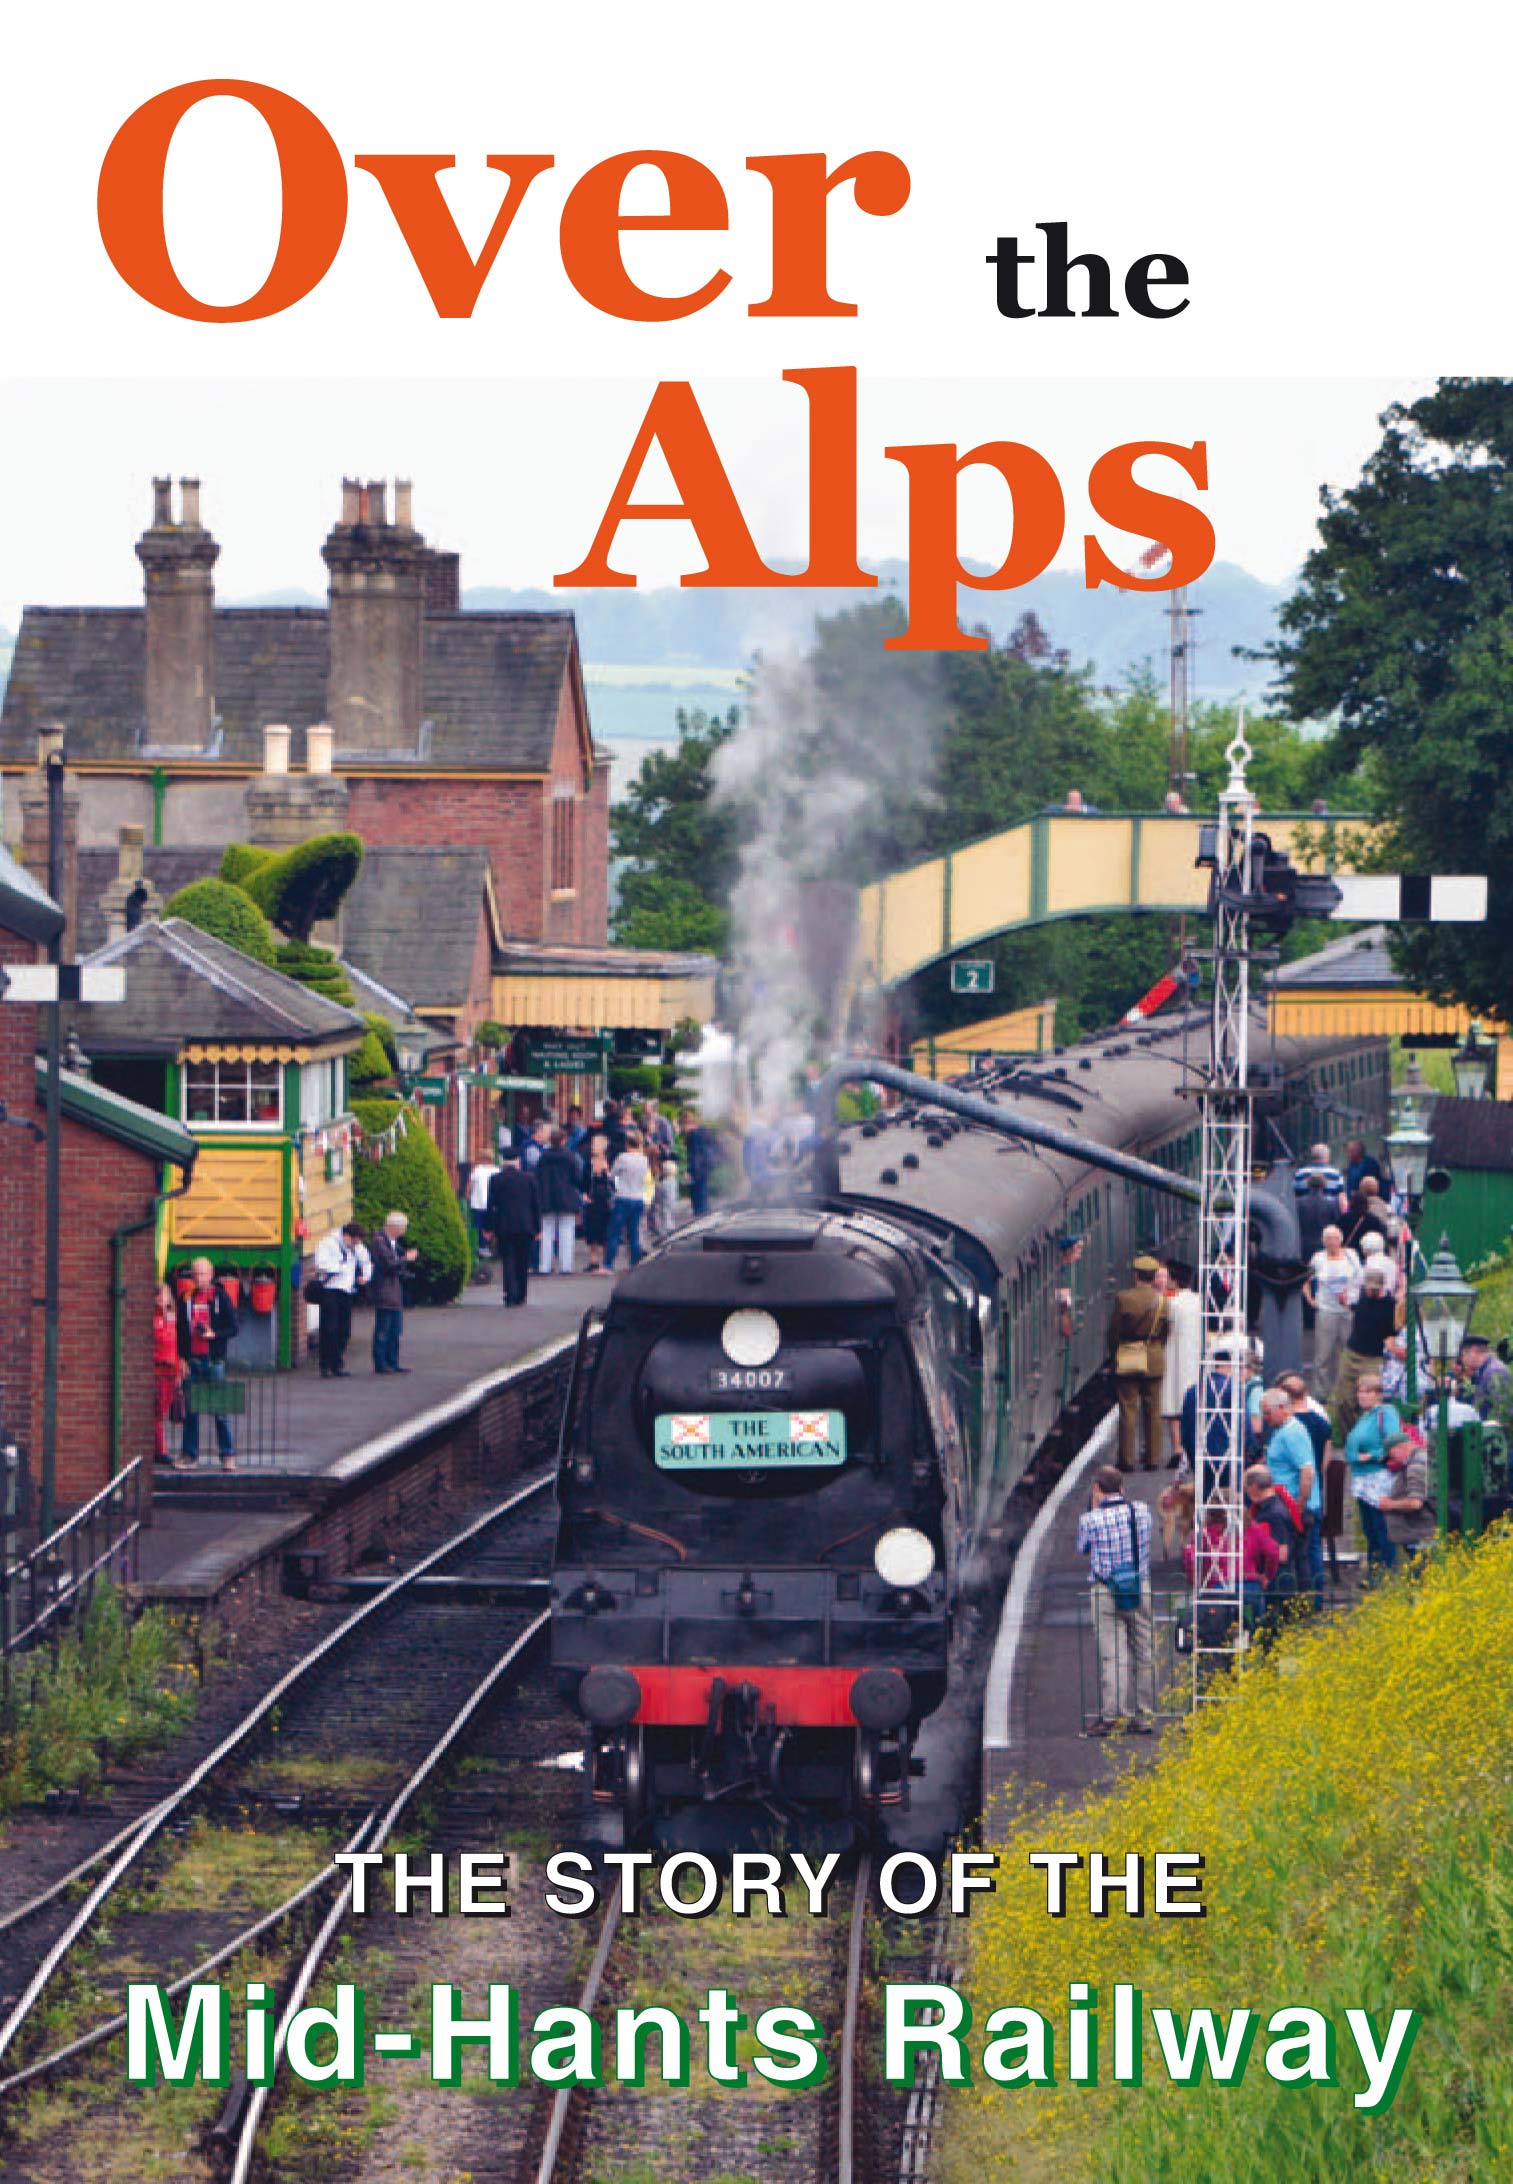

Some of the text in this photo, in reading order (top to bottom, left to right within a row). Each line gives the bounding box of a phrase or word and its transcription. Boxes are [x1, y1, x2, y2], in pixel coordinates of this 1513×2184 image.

[966, 970, 979, 988] 2
[717, 1370, 785, 1389] 34007
[728, 1419, 769, 1437] THE
[659, 1440, 841, 1461] SOUTH AMERICAN
